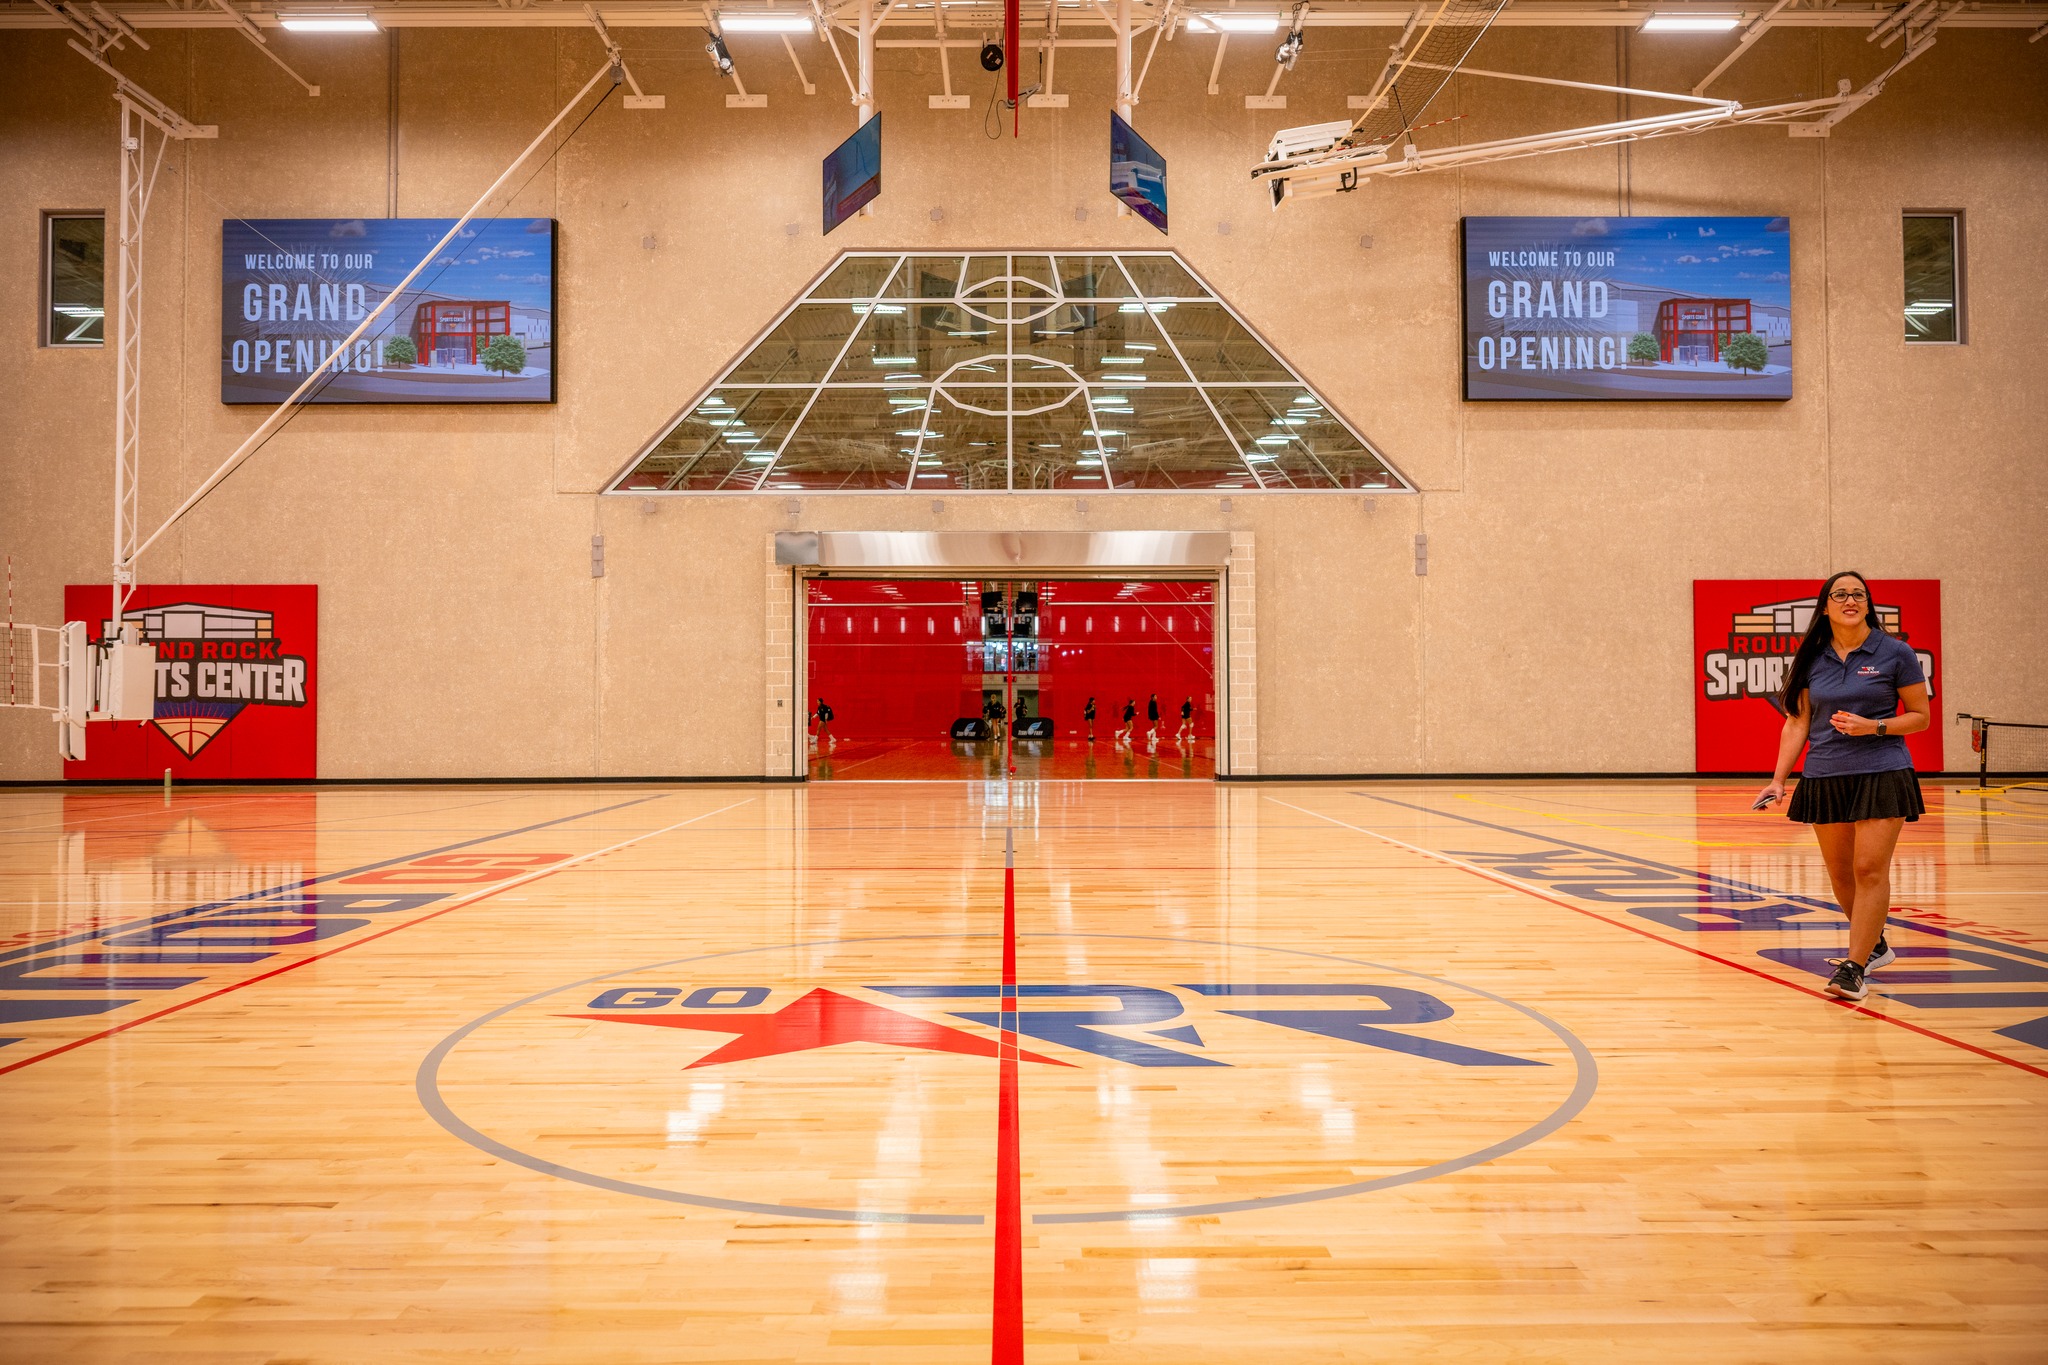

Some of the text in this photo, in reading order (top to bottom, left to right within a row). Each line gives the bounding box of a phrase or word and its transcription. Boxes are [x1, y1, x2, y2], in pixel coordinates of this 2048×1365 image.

[245, 254, 373, 270] WELCOME TO OUR
[1488, 251, 1615, 267] WELCOME TO OUR
[243, 283, 366, 322] GRAND
[1488, 280, 1609, 319] GRAND
[232, 339, 384, 374] OPENING!
[1478, 336, 1628, 371] OPENING!
[202, 641, 275, 660] ROCK
[1733, 636, 1806, 654] ROUN
[197, 658, 306, 702] CENTER
[1706, 652, 1796, 696] SPOR
[586, 982, 1555, 1068] GO RR
